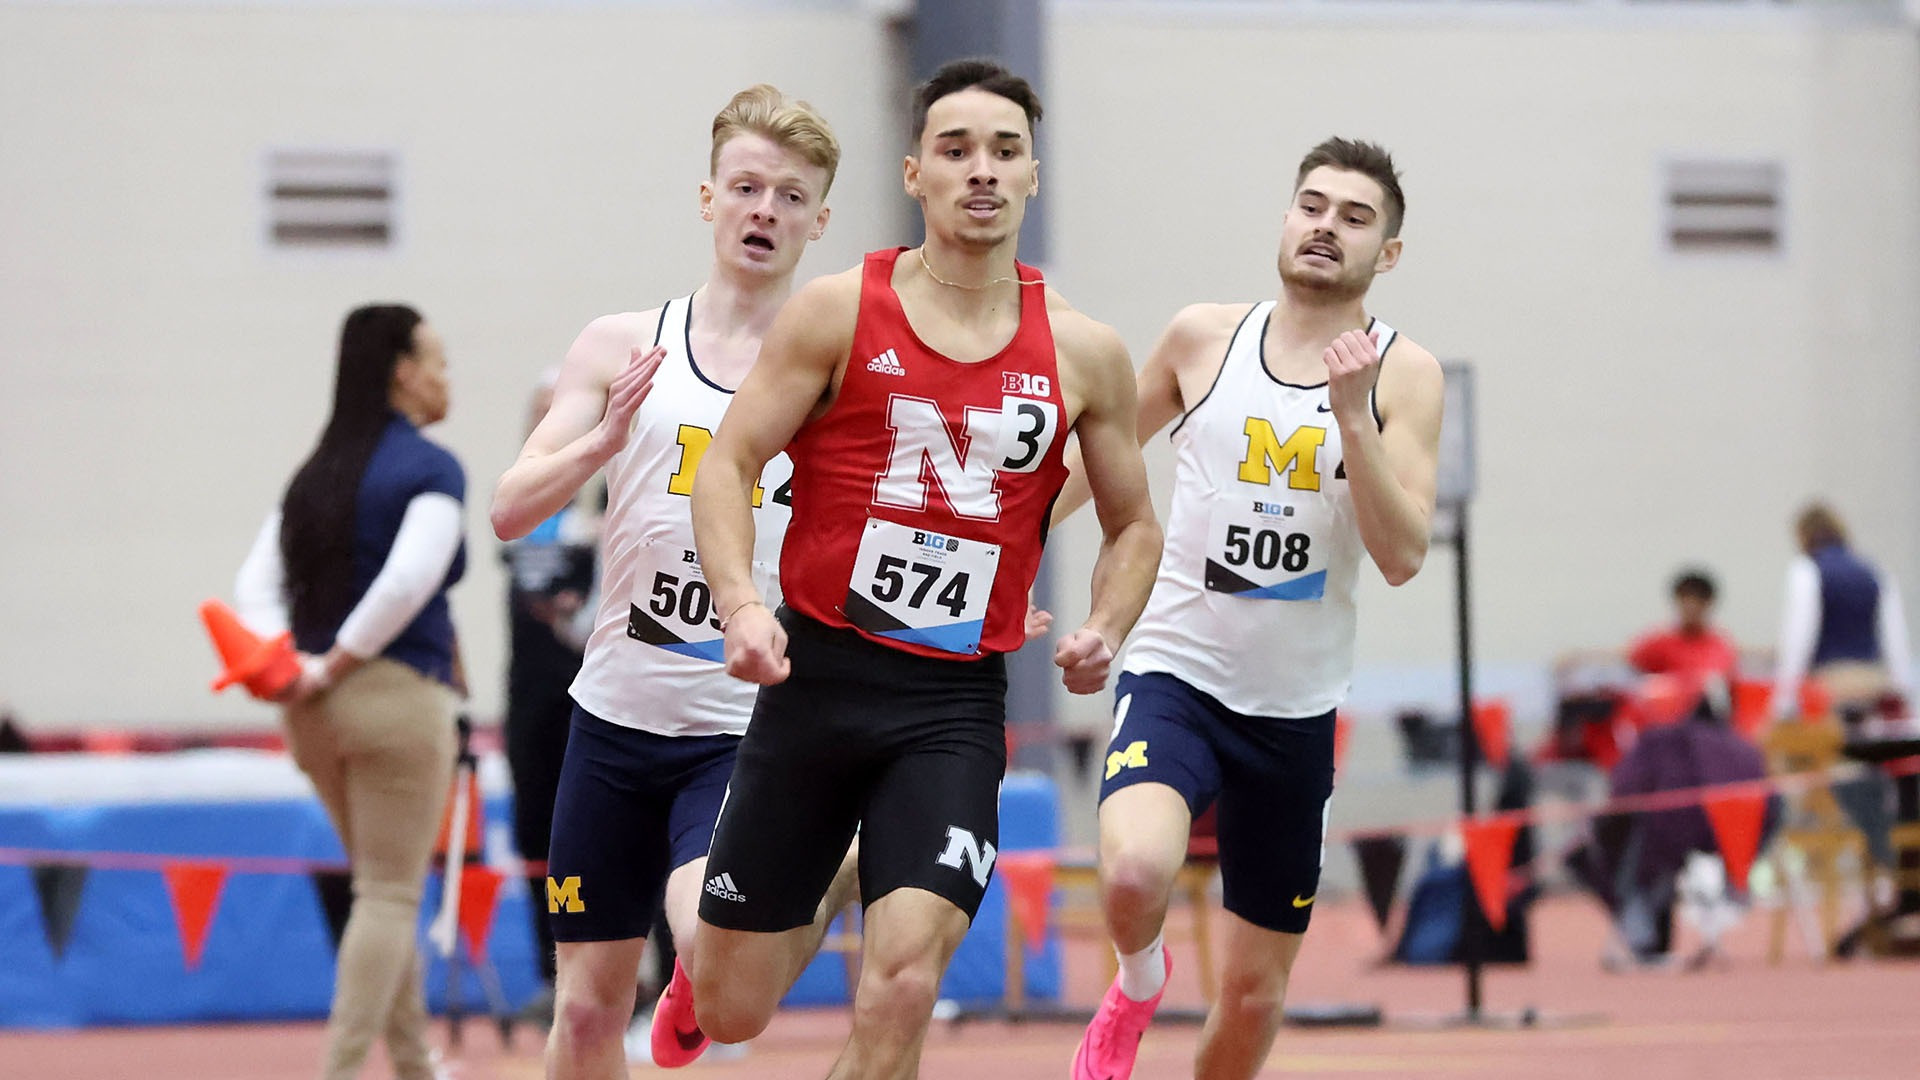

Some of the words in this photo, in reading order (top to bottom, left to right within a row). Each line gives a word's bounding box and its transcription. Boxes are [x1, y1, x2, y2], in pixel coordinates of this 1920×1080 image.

[867, 362, 906, 377] adidas
[872, 393, 1002, 523] N
[1002, 404, 1046, 469] 3
[1238, 416, 1326, 492] M
[1224, 524, 1311, 572] 508
[650, 571, 724, 631] 50
[871, 554, 970, 618] 574
[1105, 741, 1148, 781] M
[935, 825, 997, 888] N
[547, 876, 585, 913] M
[705, 882, 747, 903] adidas
